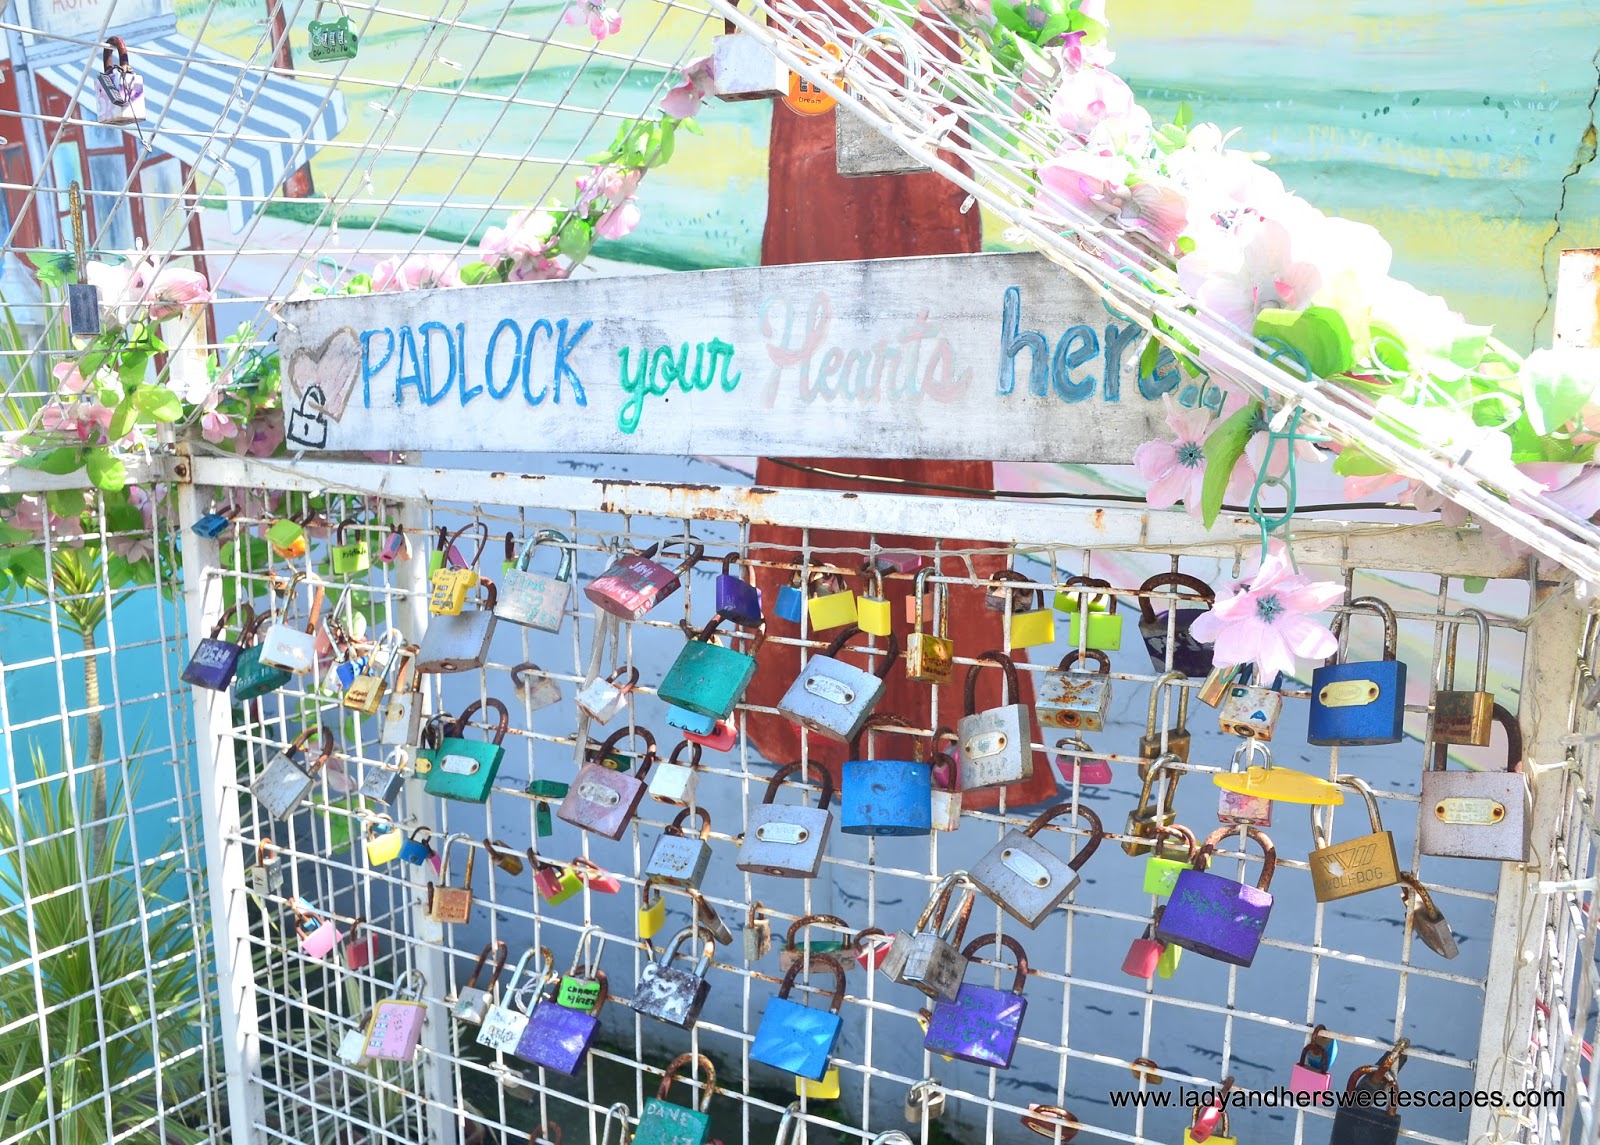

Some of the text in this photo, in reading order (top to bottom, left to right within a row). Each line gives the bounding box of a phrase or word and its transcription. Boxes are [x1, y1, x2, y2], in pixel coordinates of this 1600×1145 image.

[798, 96, 821, 104] Dream
[360, 317, 593, 408] PADLOCK
[617, 336, 741, 434] your
[758, 291, 974, 410] Hearts
[1321, 867, 1383, 890] WOLFDOG
